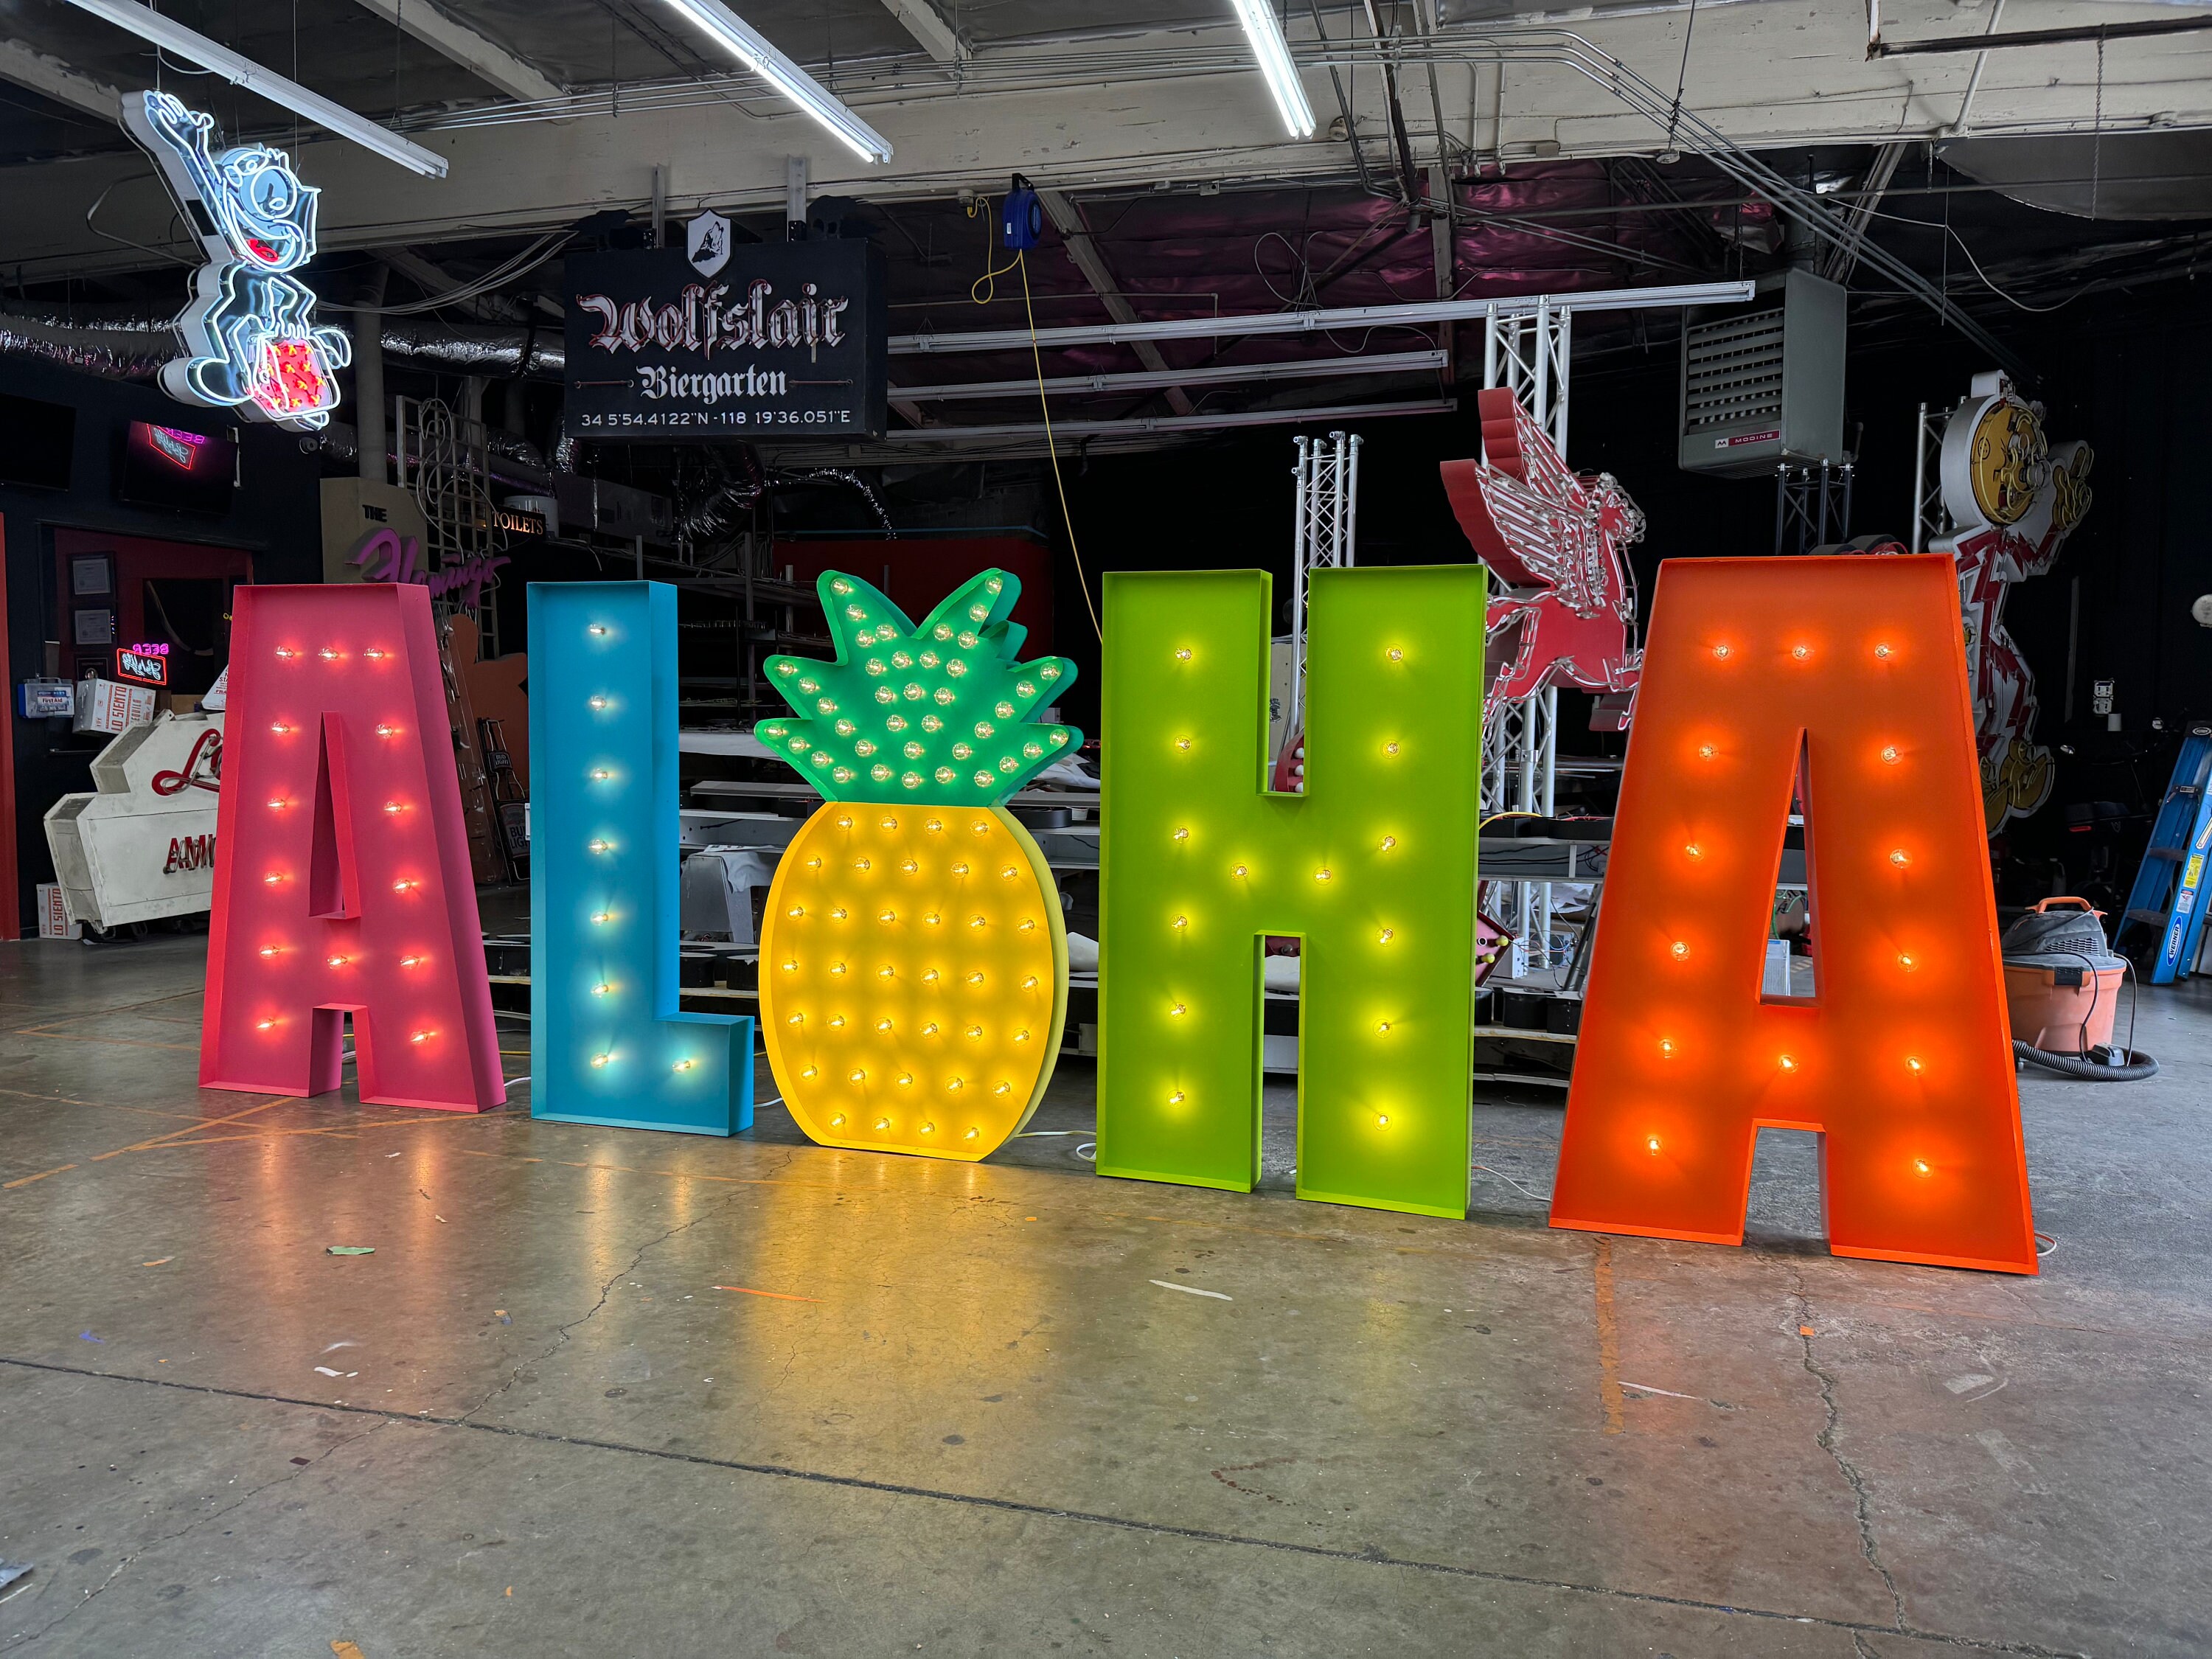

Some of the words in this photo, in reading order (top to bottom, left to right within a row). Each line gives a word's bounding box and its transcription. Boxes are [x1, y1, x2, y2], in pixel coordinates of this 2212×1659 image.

[575, 279, 849, 363] Wolfslair
[636, 364, 787, 405] Biergarten
[581, 414, 602, 427] 34
[1734, 433, 1773, 443] MODINE
[362, 504, 387, 522] THE
[492, 510, 543, 535] TOILETS
[112, 686, 128, 719] SIENTO
[131, 698, 142, 723] EQUILA
[111, 720, 124, 732] LO
[54, 925, 63, 936] LO
[2168, 926, 2180, 956] WERNER
